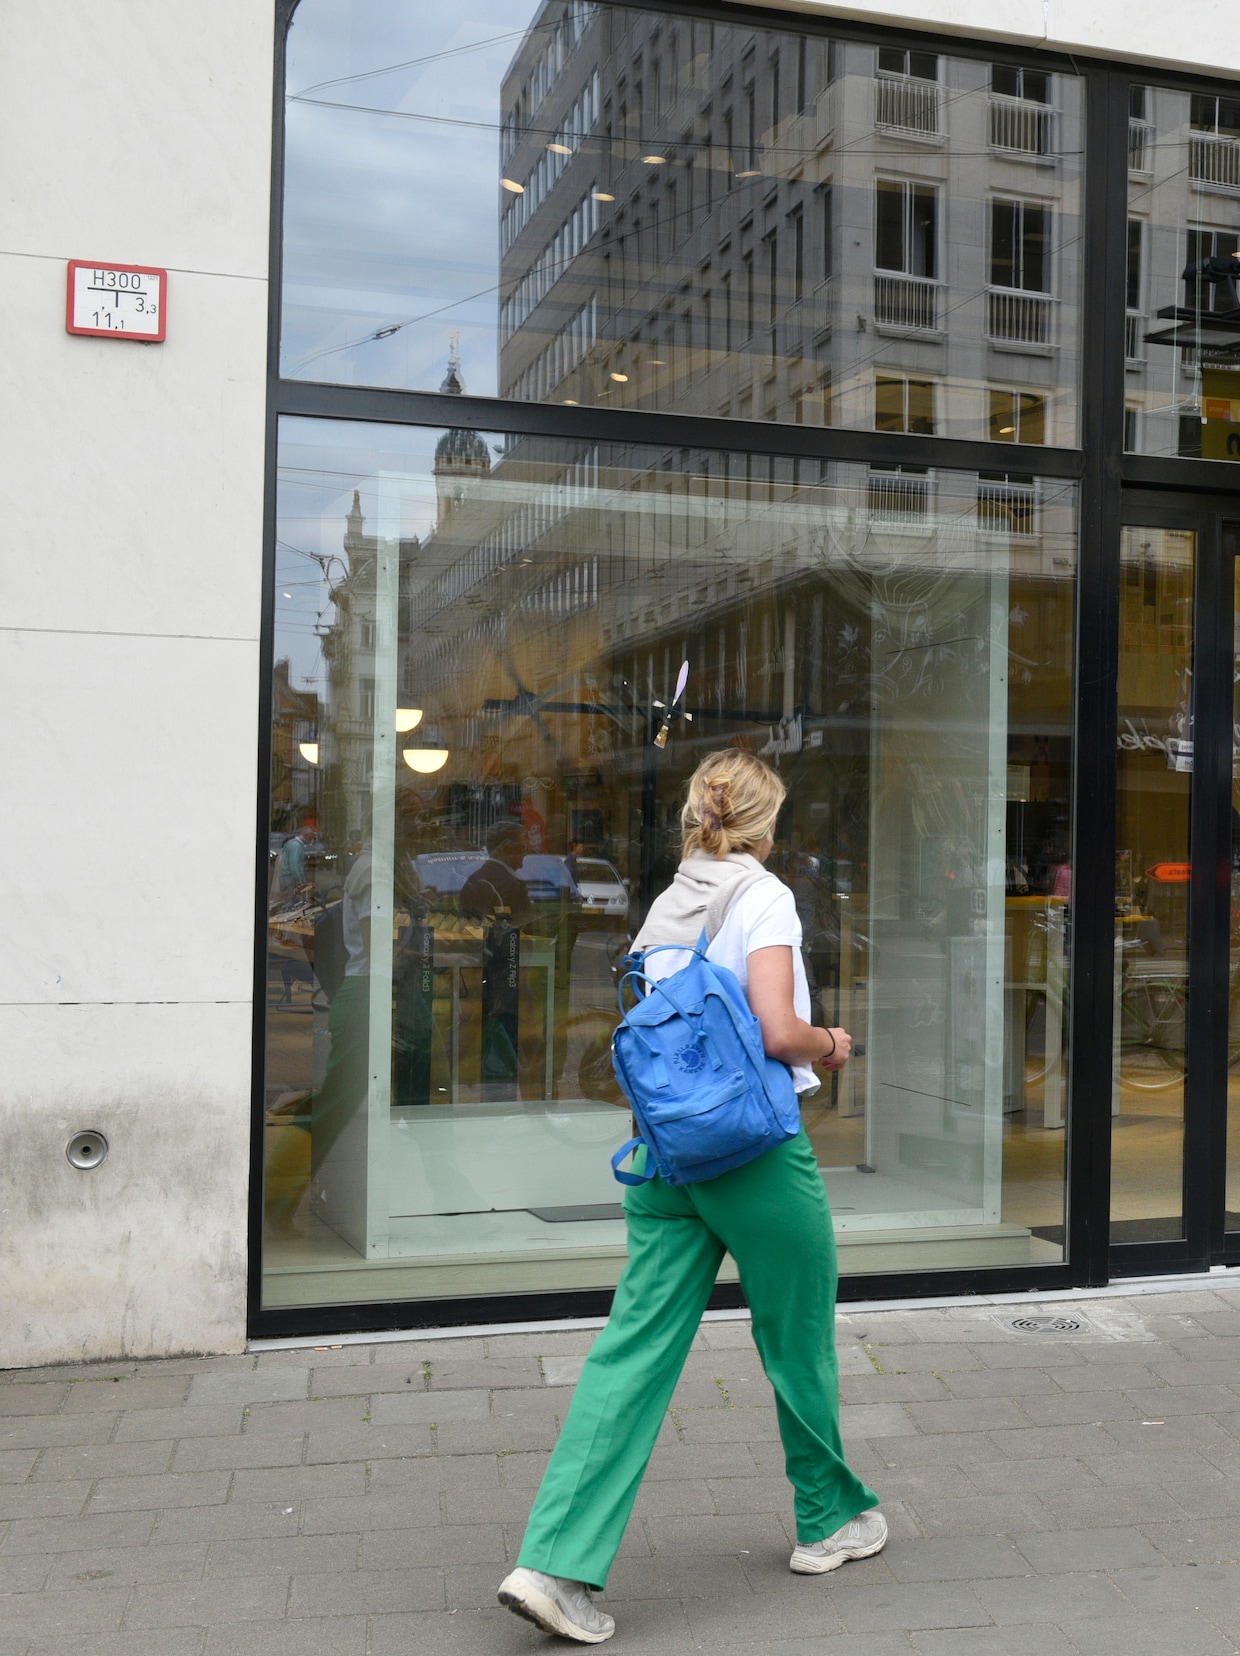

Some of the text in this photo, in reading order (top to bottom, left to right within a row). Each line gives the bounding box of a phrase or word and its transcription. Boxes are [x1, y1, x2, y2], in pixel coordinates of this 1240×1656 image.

[93, 270, 141, 290] H300
[92, 311, 124, 330] 11,1
[420, 932, 432, 963] Galaxy
[507, 932, 518, 963] Galaxy
[421, 970, 431, 992] Fold3
[506, 970, 518, 988] Flip3
